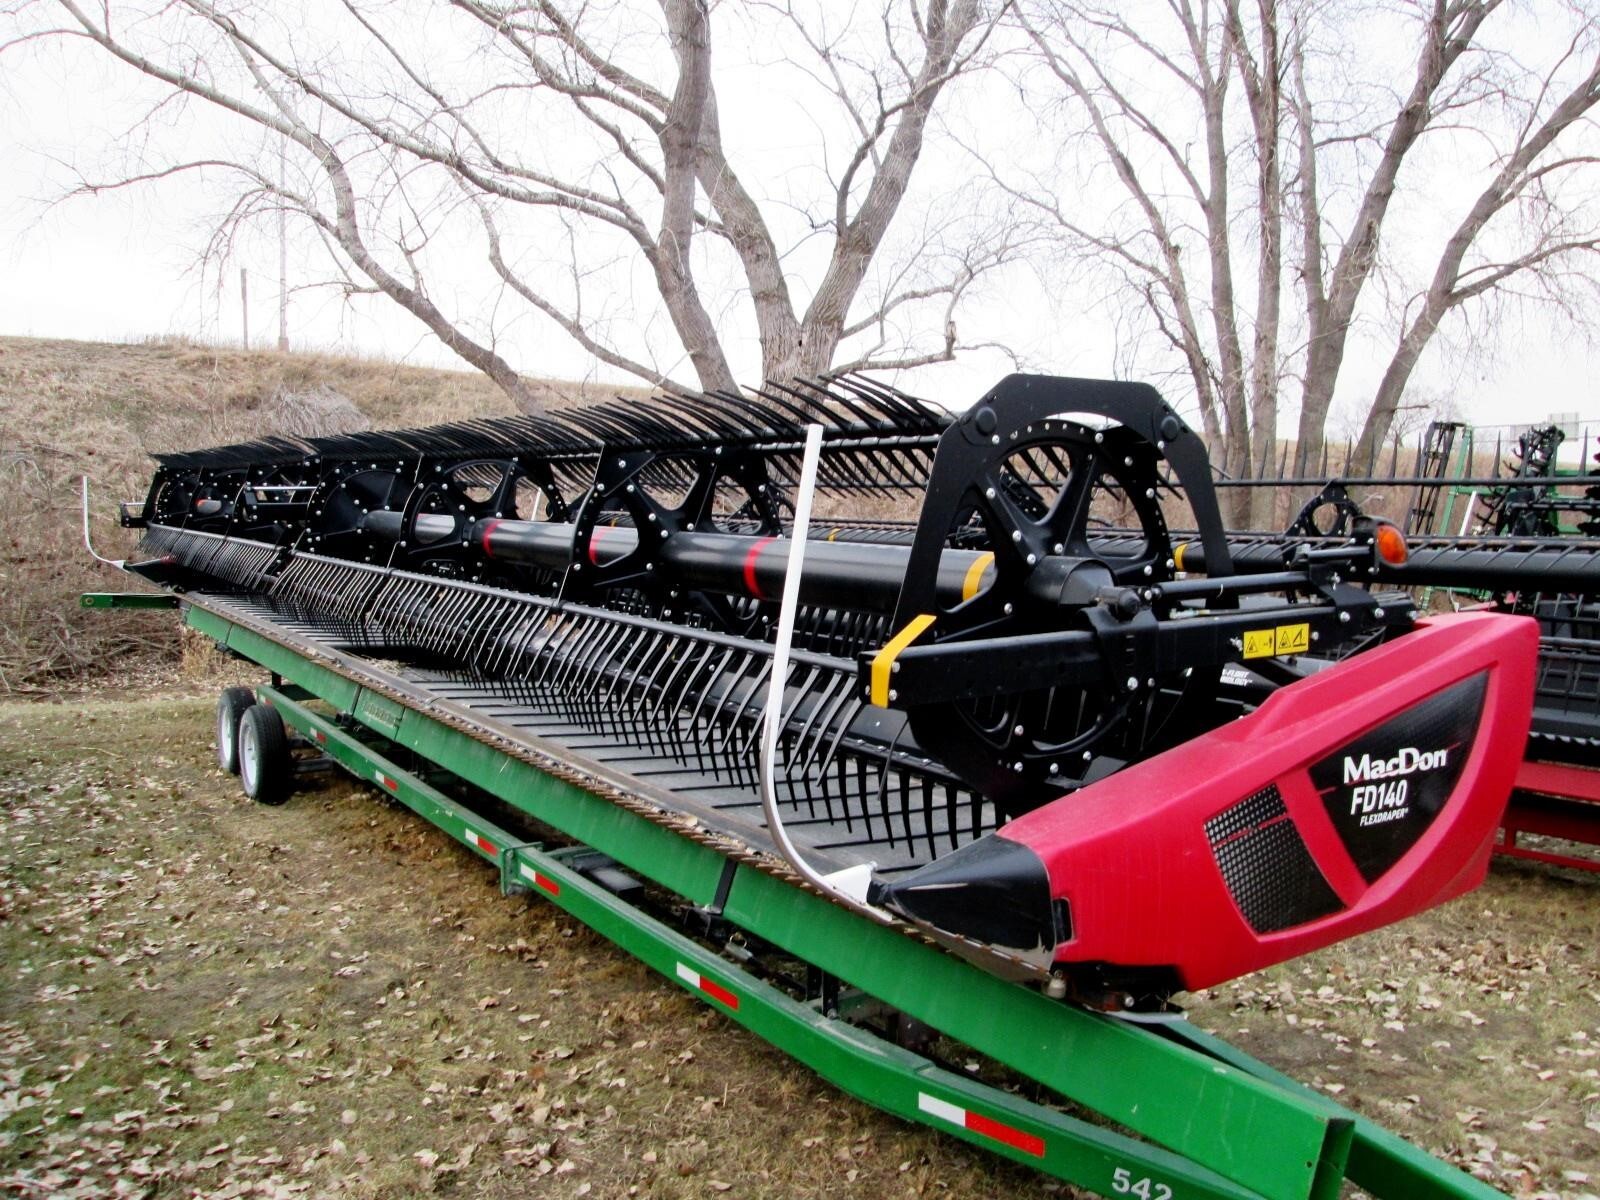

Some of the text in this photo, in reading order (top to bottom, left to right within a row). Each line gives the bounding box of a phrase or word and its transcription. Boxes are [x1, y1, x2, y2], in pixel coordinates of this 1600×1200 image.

[1343, 747, 1448, 784] MacDon
[1350, 780, 1408, 815] FD140
[1111, 1167, 1172, 1200] 542
